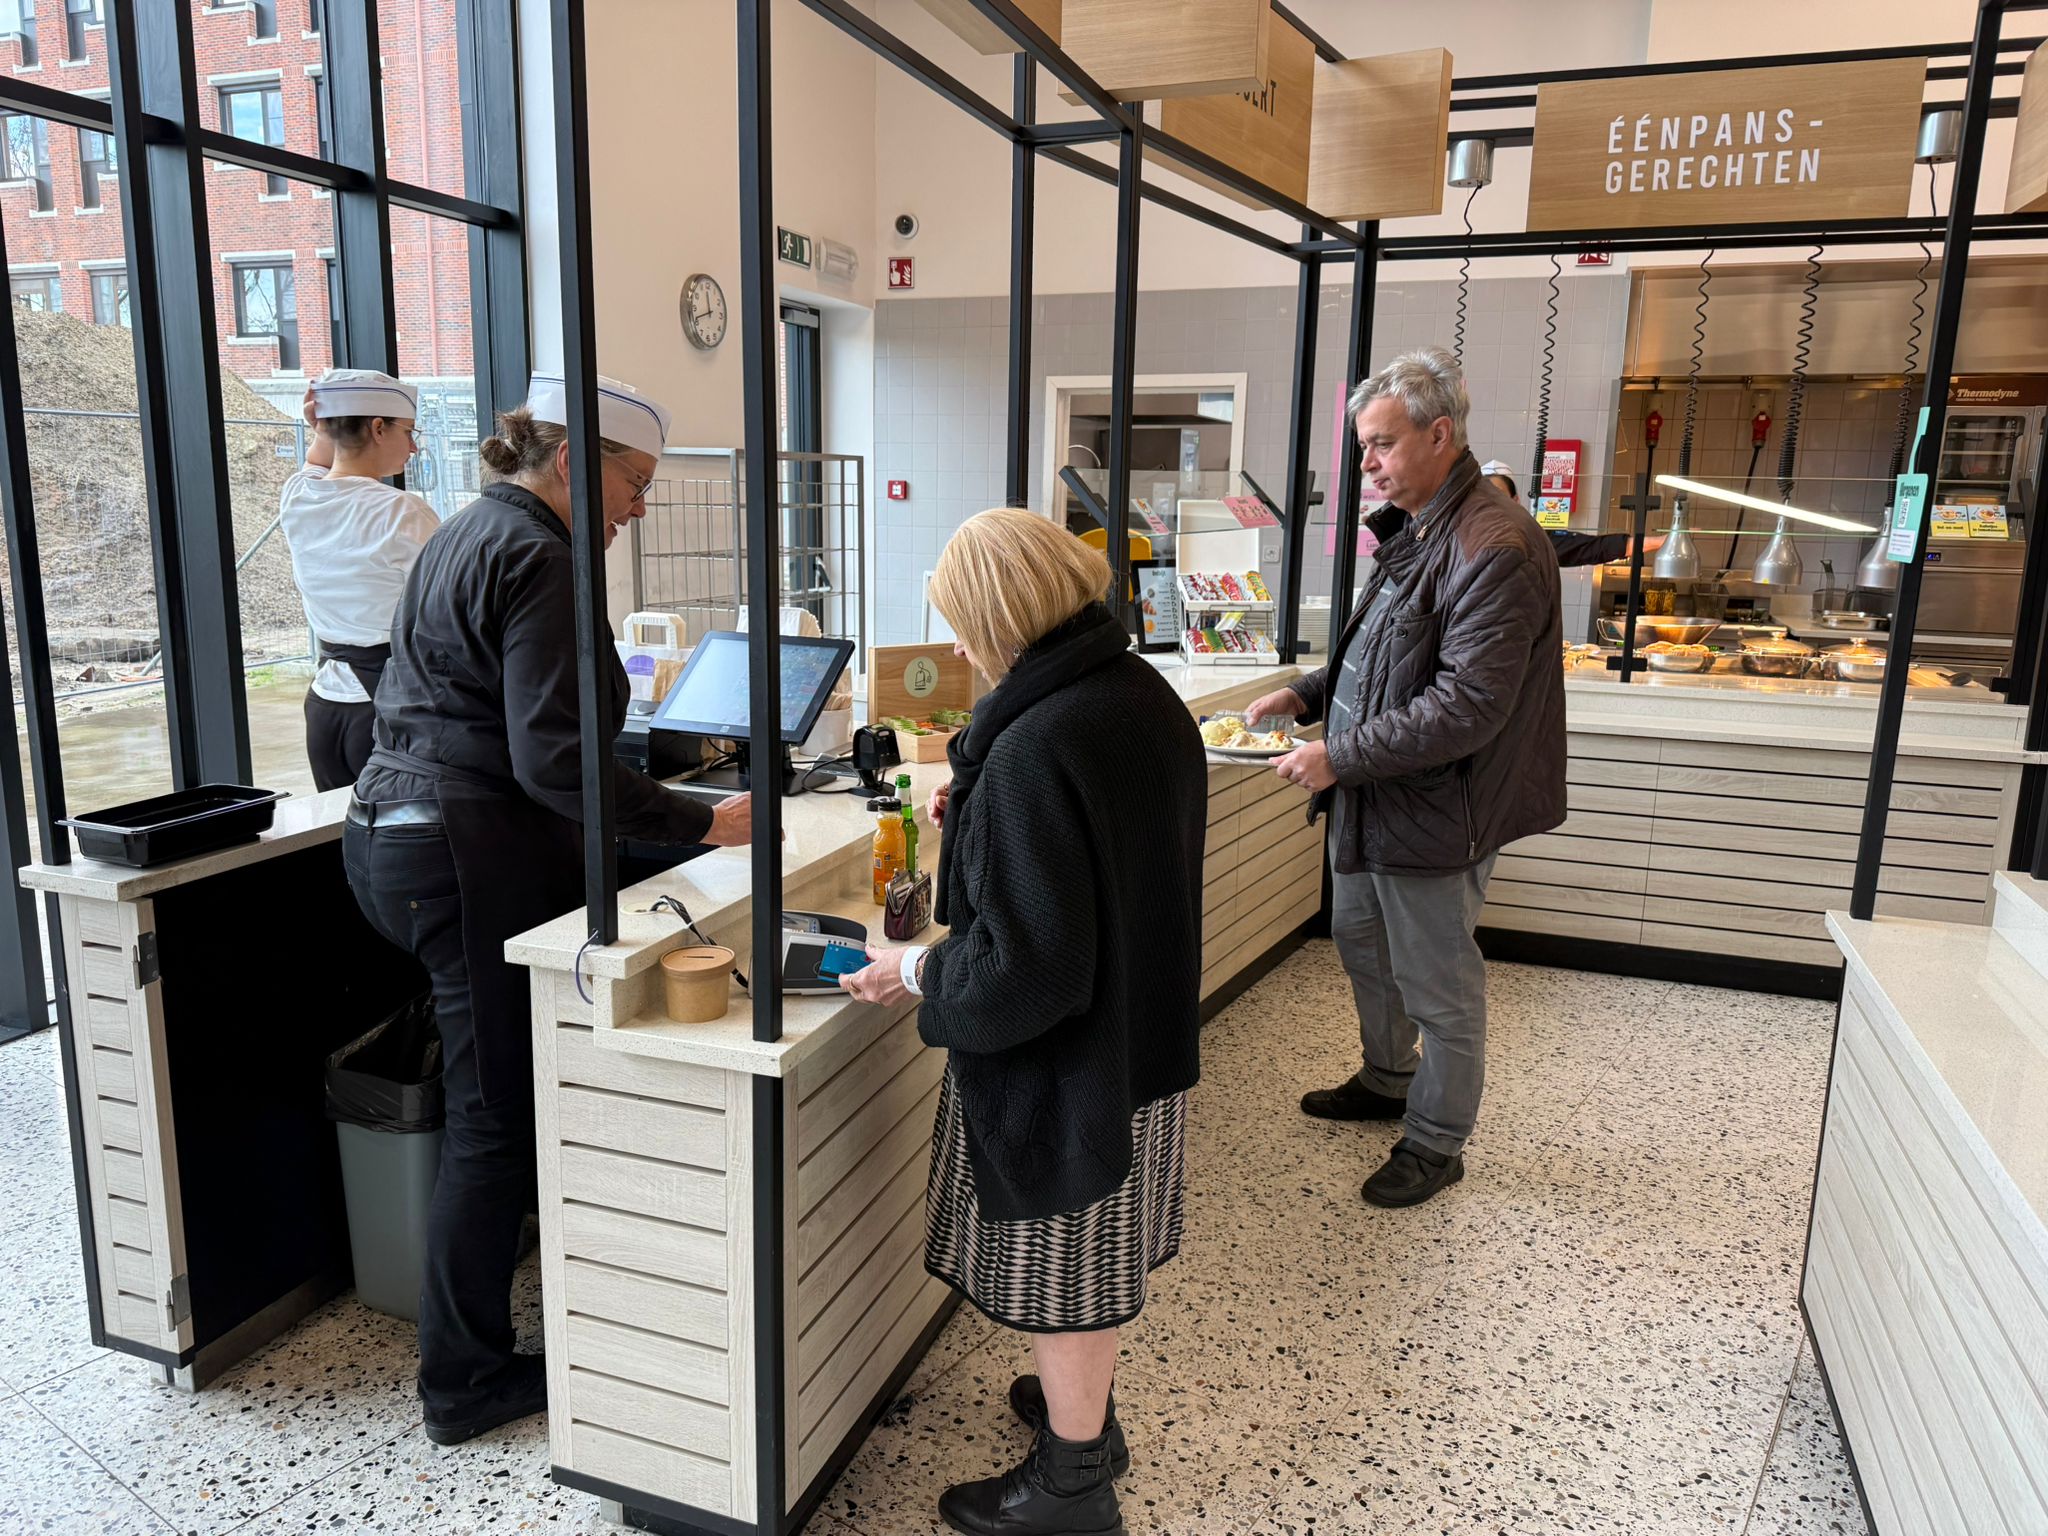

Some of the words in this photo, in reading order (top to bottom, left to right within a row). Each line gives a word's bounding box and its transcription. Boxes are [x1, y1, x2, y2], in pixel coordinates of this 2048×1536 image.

[1607, 108, 1823, 154] ÉÉNPANS-
[1605, 148, 1820, 194] GERECHTEN
[1956, 388, 2020, 400] Thermodyne
